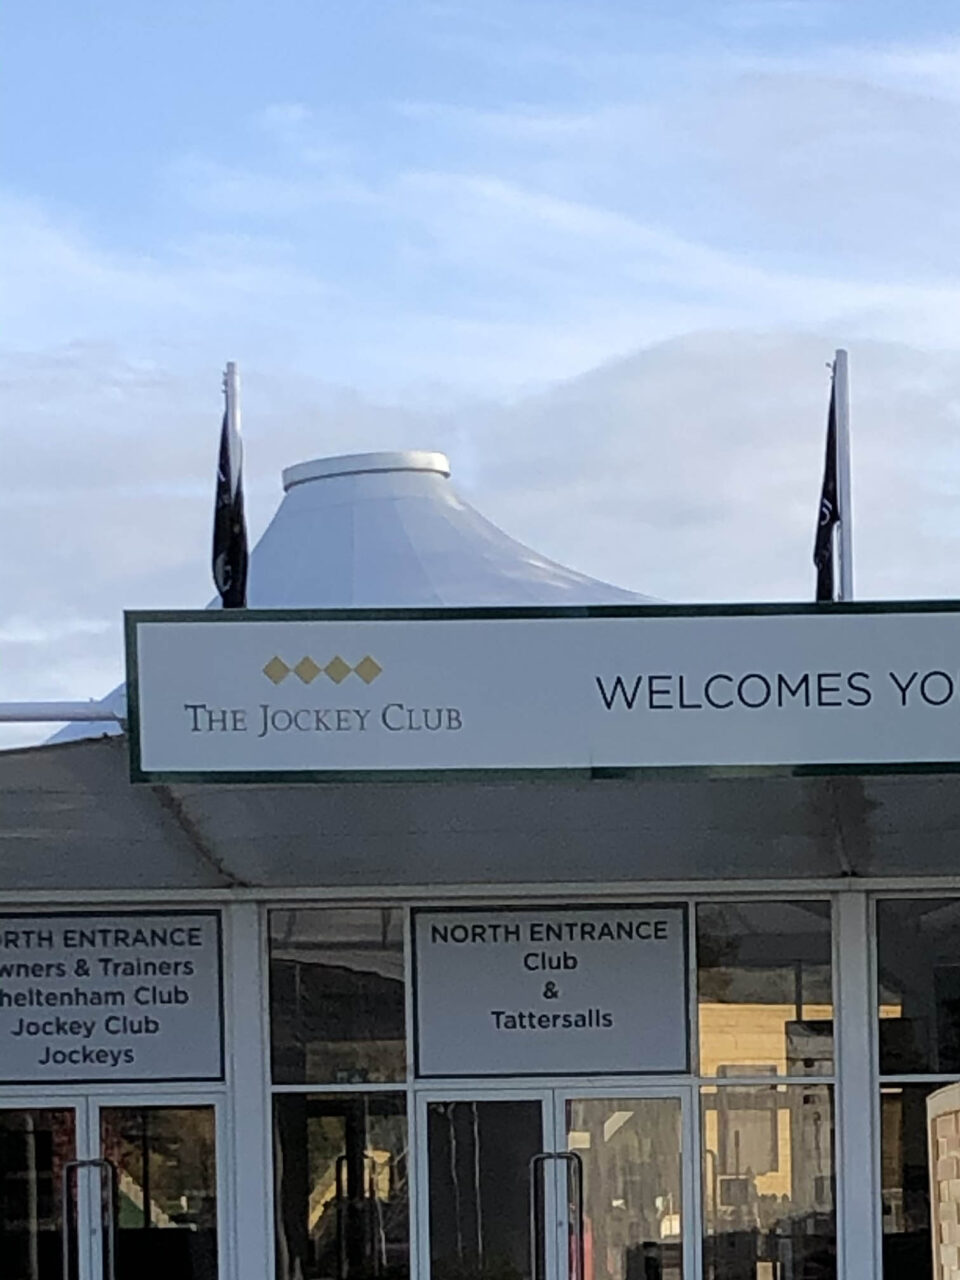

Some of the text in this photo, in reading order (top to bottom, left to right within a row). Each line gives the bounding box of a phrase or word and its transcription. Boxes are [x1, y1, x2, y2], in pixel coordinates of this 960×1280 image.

[595, 671, 872, 710] WELCOMES
[183, 703, 463, 738] THE JOCKEY CLUB
[0, 927, 203, 949] RTH ENTRANCE
[431, 920, 668, 944] NORTH ENTRANCE
[74, 958, 91, 978] &
[97, 957, 195, 977] Trainers
[523, 950, 578, 971] Club
[133, 984, 190, 1006] Club
[542, 980, 560, 1000] &
[10, 1015, 160, 1039] Jockey Club
[490, 1008, 613, 1030] Tattersalls
[37, 1044, 135, 1068] Jockeys
